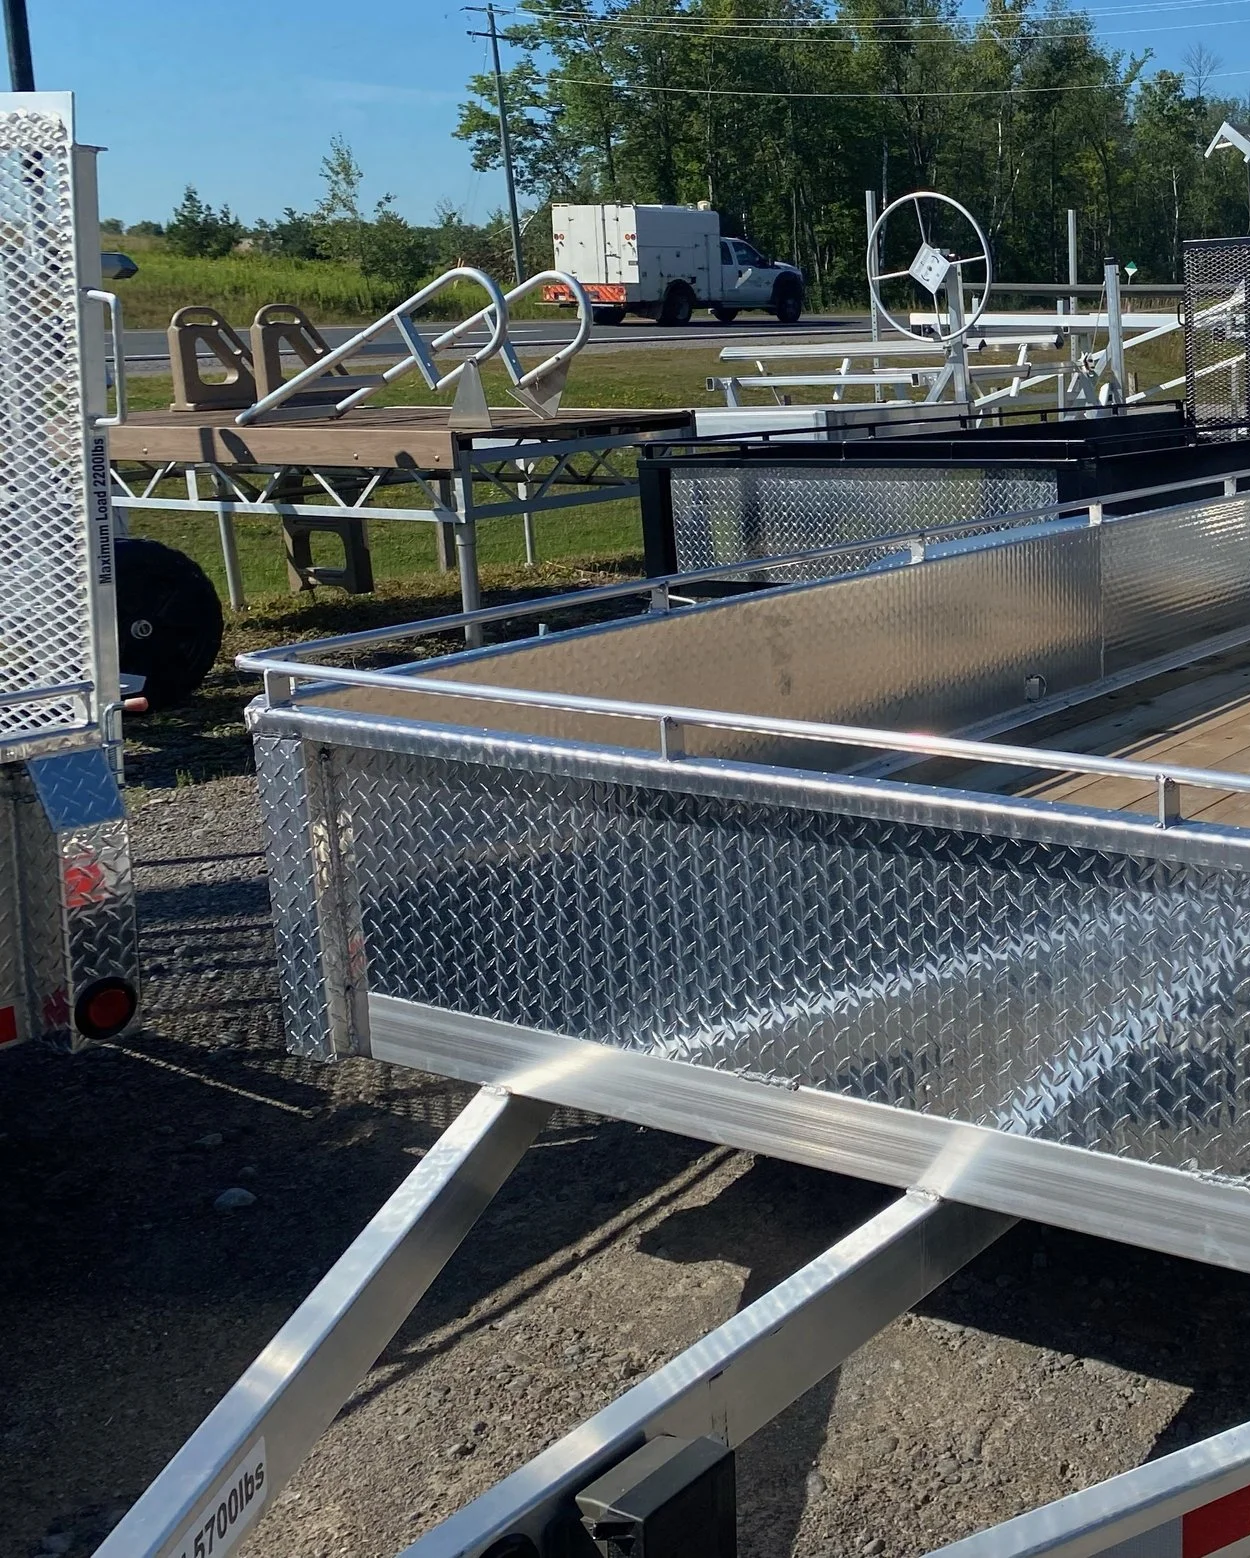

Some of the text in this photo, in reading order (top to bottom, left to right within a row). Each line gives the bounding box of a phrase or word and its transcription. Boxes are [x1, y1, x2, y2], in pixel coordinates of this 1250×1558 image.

[92, 438, 112, 585] Maximum Load 2200lbs
[193, 1462, 264, 1558] 5700lbs
